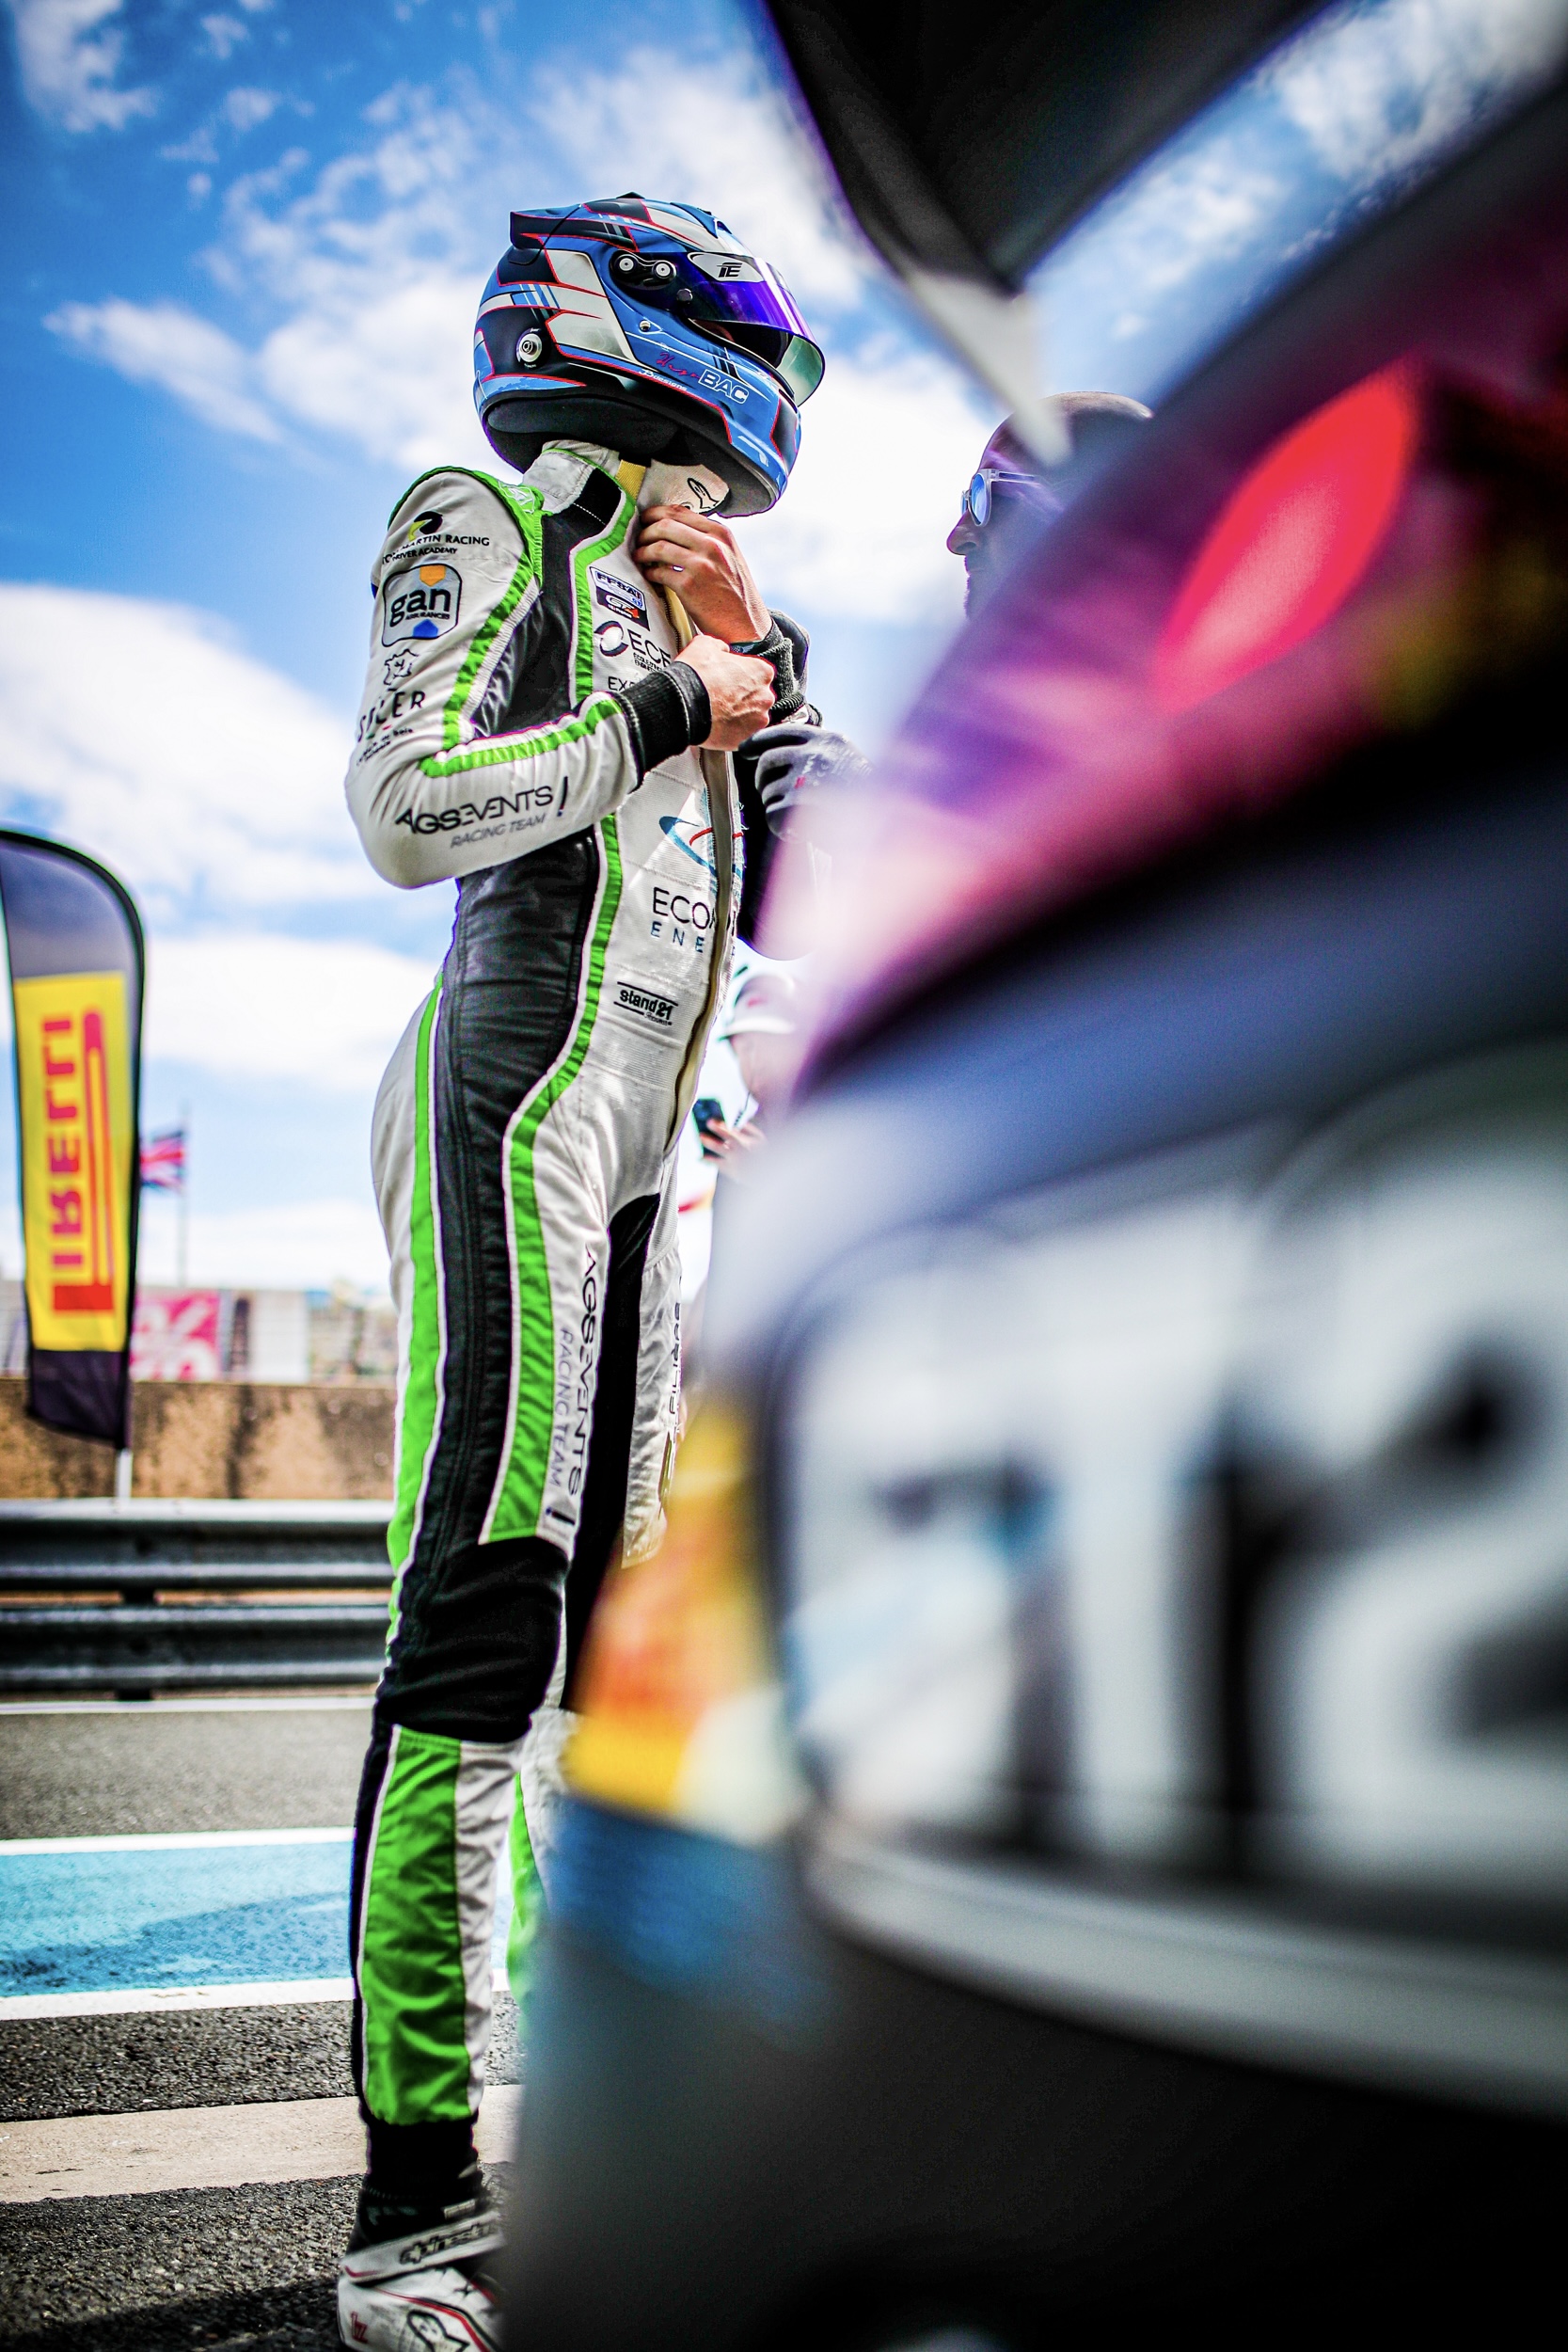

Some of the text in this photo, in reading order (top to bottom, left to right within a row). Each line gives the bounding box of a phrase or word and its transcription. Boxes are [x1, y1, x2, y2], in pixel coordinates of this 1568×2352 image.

[698, 369, 750, 405] BAC
[418, 547, 458, 557] ACADEMY
[445, 533, 490, 547] RACING
[389, 588, 451, 628] gan
[450, 813, 546, 848] RACING TEAM
[619, 989, 673, 1021] stand21
[547, 1327, 574, 1488] RACING TEAM
